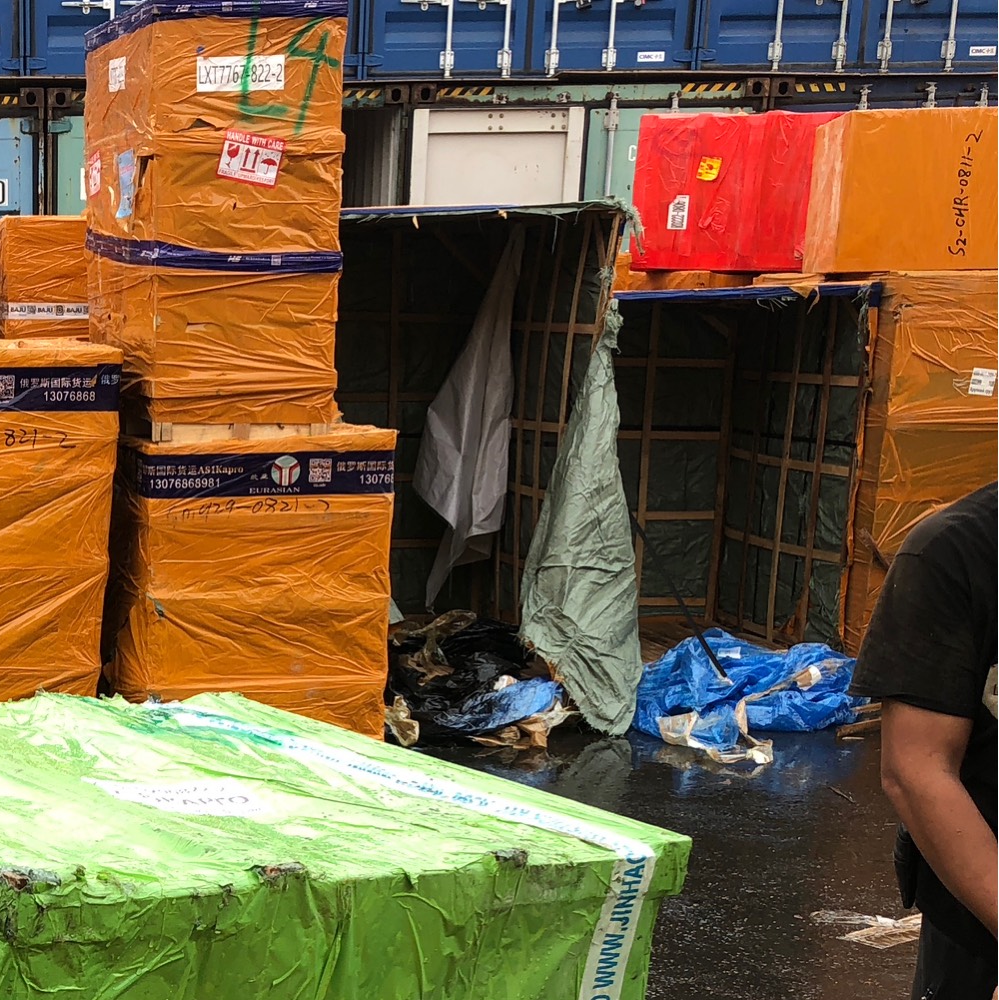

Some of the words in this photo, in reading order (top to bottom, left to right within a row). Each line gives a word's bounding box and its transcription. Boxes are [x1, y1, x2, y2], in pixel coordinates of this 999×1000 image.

[226, 130, 251, 144] HANDLE
[251, 136, 267, 146] WITH
[267, 139, 284, 151] CARE
[43, 390, 96, 402] 13076868
[150, 477, 221, 489] 13076868981
[249, 486, 300, 494] EURASIAN
